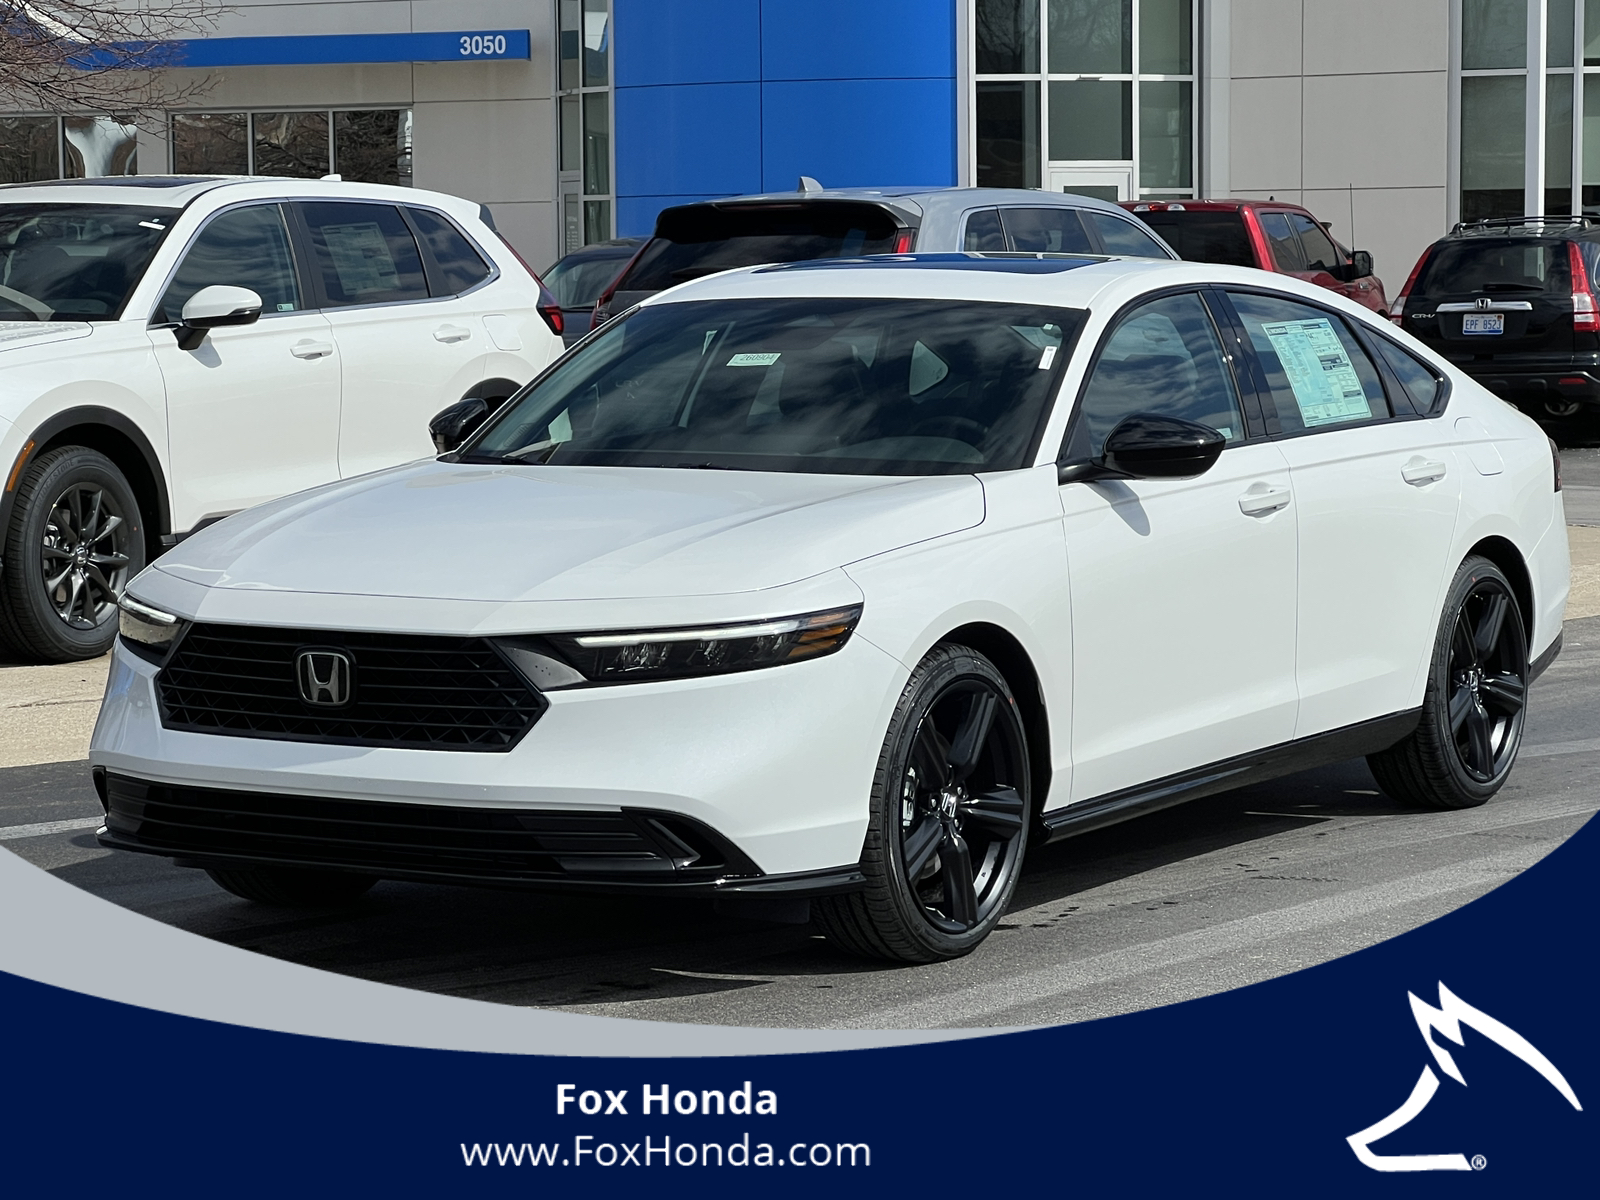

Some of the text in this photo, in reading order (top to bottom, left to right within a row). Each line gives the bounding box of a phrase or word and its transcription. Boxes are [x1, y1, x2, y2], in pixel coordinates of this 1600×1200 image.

[459, 34, 507, 55] 3050
[1465, 319, 1502, 330] EPF 8523
